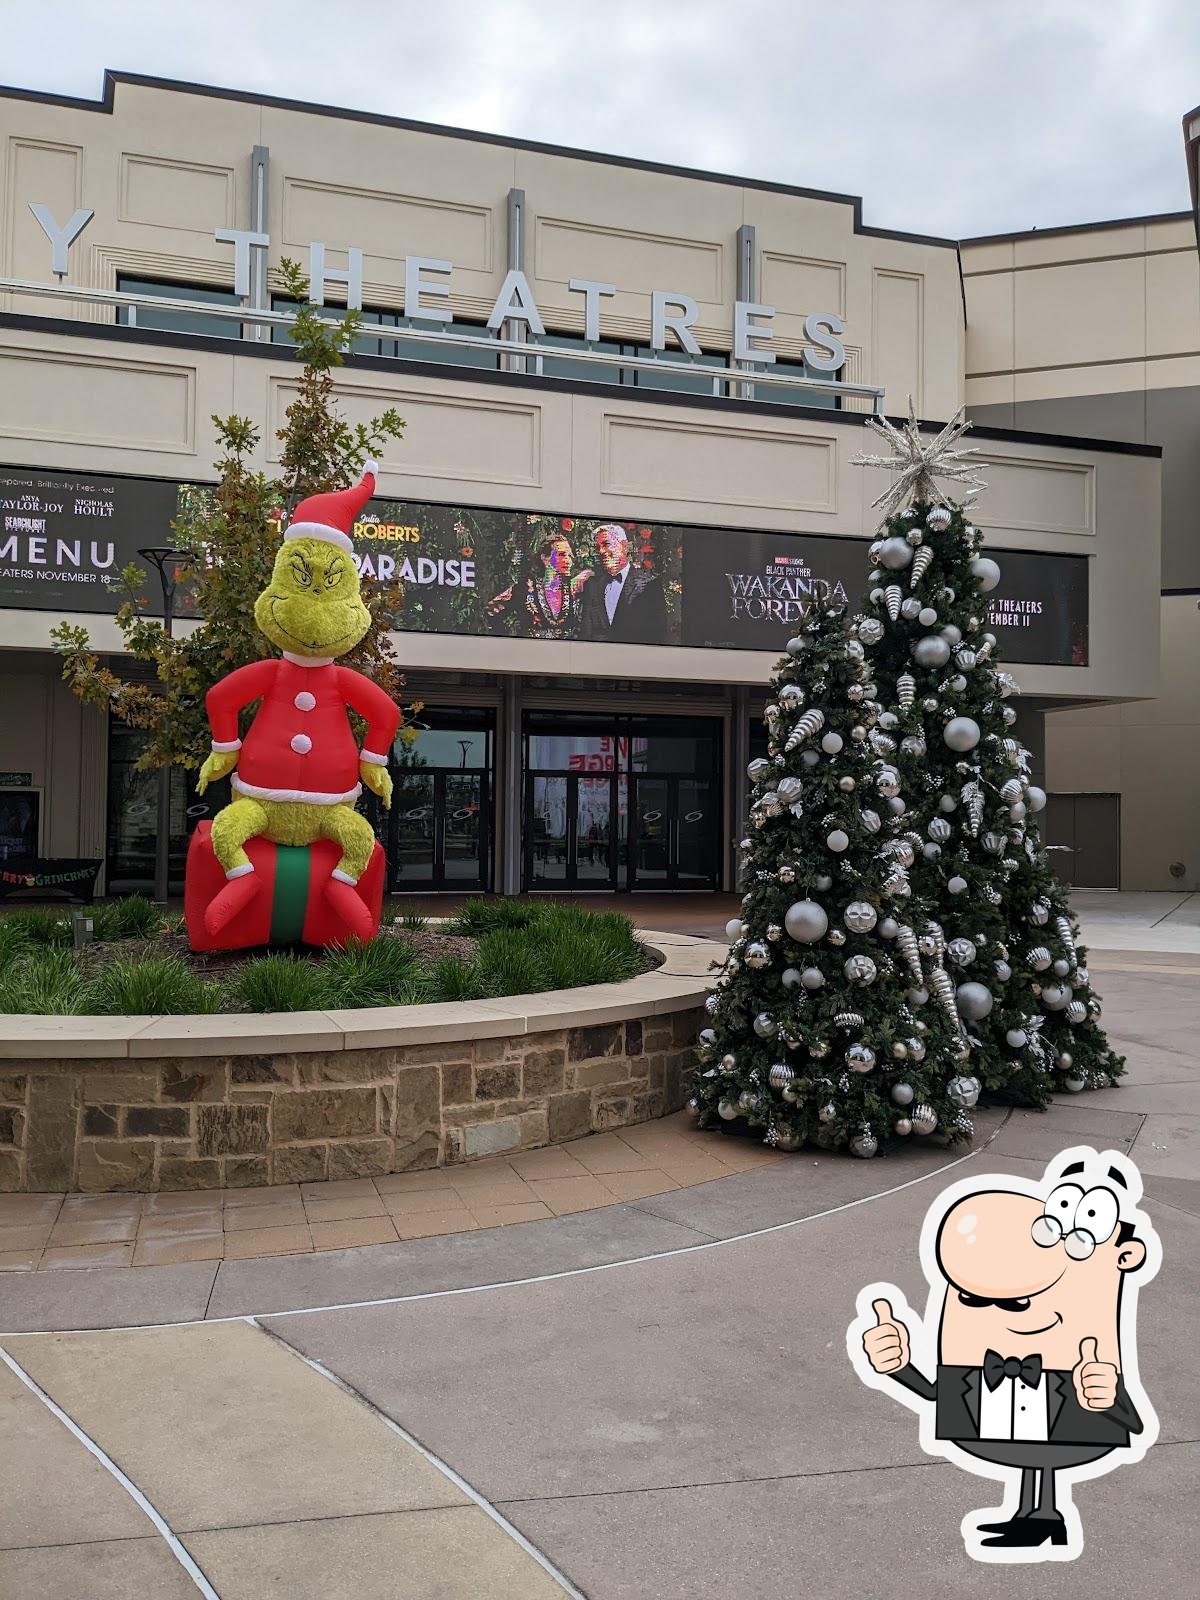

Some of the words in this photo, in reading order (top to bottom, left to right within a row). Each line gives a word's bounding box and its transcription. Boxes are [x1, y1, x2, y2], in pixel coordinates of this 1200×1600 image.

[28, 201, 95, 275] Y
[215, 227, 846, 372] THEATRES
[20, 495, 40, 503] ANYA
[75, 499, 113, 508] NICHOLAS
[74, 504, 115, 517] HOULT
[360, 513, 381, 524] Julia
[353, 522, 420, 543] ROBERTS
[36, 571, 97, 583] NOVEMBER
[766, 565, 784, 577] BLACK
[786, 566, 811, 578] PANTHER
[725, 573, 849, 603] WAKANDA
[730, 596, 814, 624] FOREV
[998, 599, 1042, 614] THEATERS
